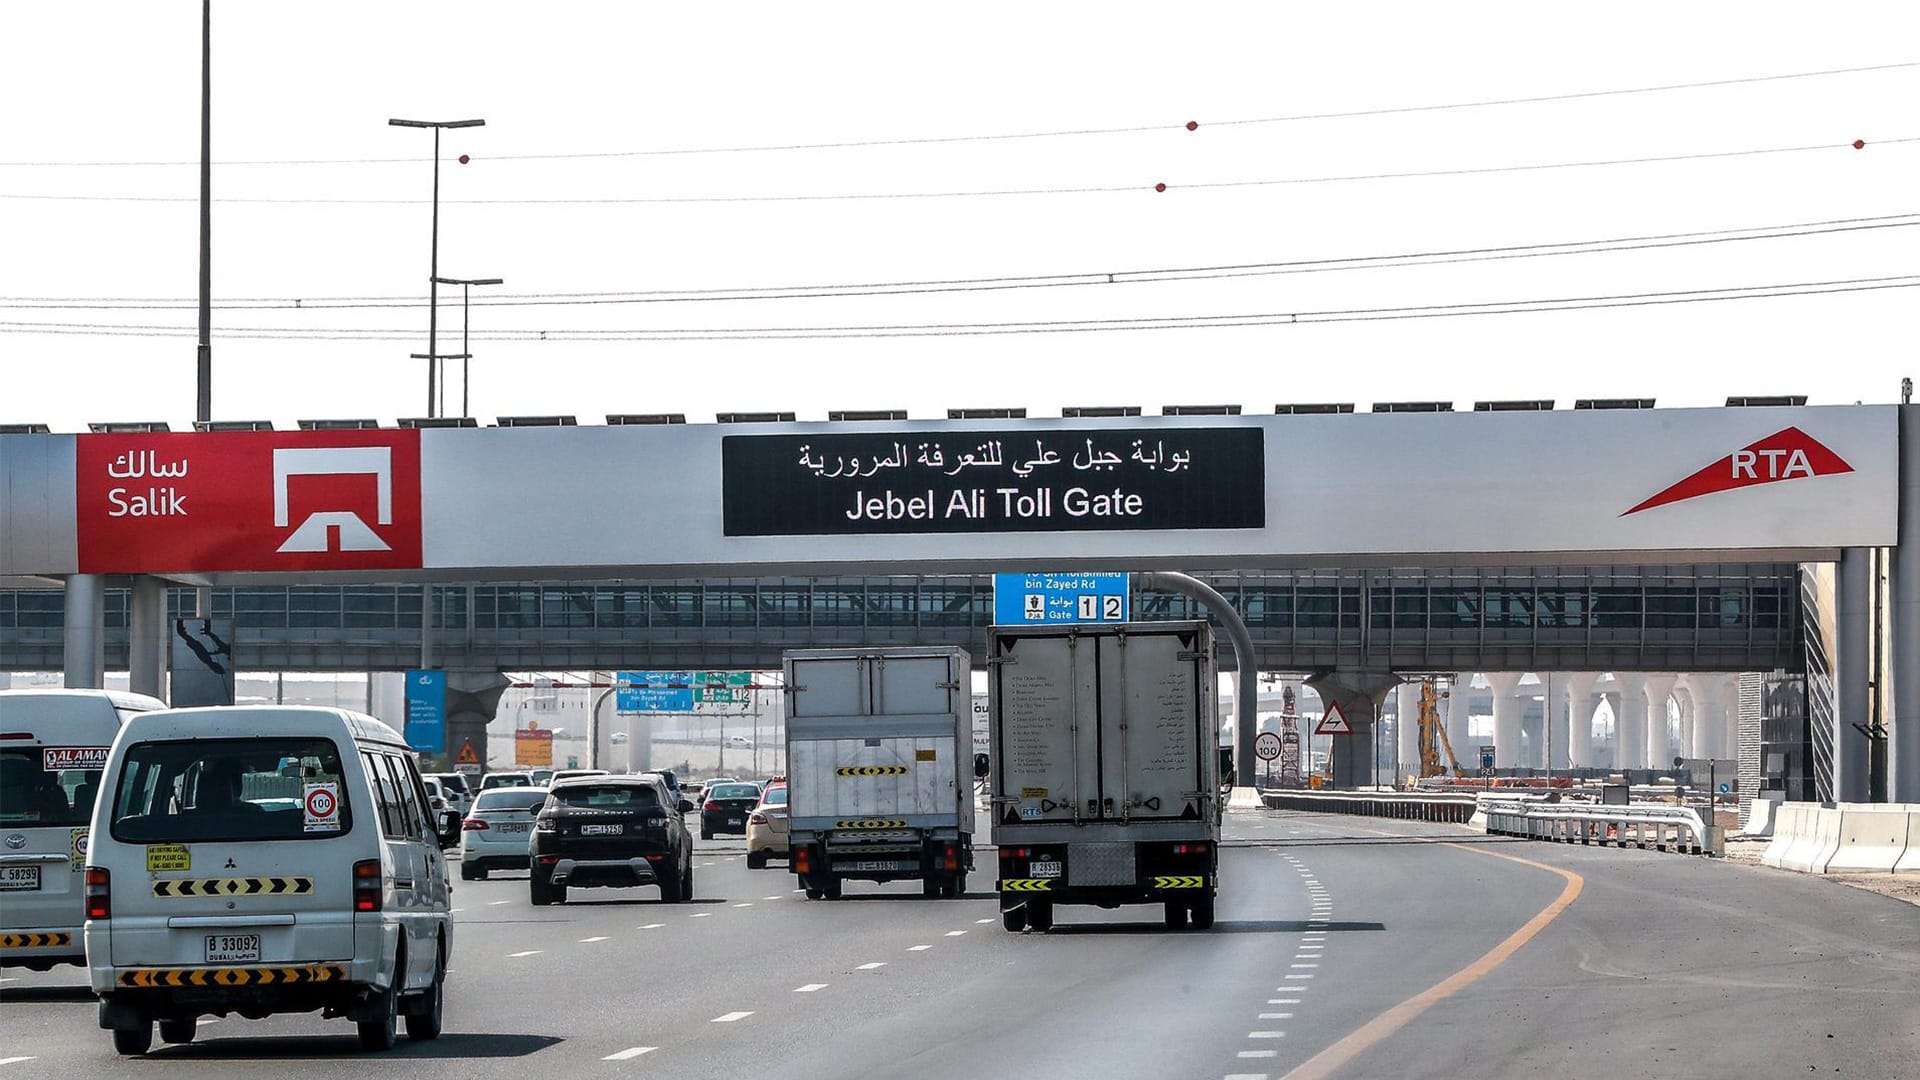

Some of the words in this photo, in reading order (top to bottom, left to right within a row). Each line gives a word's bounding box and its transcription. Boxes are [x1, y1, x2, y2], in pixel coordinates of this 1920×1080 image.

[107, 450, 188, 478] سالك
[798, 441, 908, 478] المرورية
[917, 440, 1003, 476] للتعرفة
[1012, 439, 1061, 478] علي
[1072, 438, 1123, 471] جبل
[1131, 438, 1190, 473] بوابة
[1730, 449, 1816, 479] RTA
[107, 487, 188, 517] Salik
[845, 489, 934, 520] Jebel
[945, 488, 985, 519] Ali
[996, 487, 1051, 518] Toll
[1063, 487, 1143, 517] Gate
[1025, 579, 1042, 589] bin
[1046, 579, 1078, 591] Zayed
[1081, 579, 1096, 589] Rd
[1049, 610, 1072, 619] Gate
[1083, 598, 1090, 617] 1
[1106, 598, 1120, 617] 2
[57, 750, 73, 761] AL
[1259, 747, 1277, 755] 100
[313, 799, 330, 808] 100
[1022, 808, 1042, 817] RTS
[9, 868, 37, 880] 58299
[209, 936, 216, 951] B
[222, 936, 258, 951] 33092
